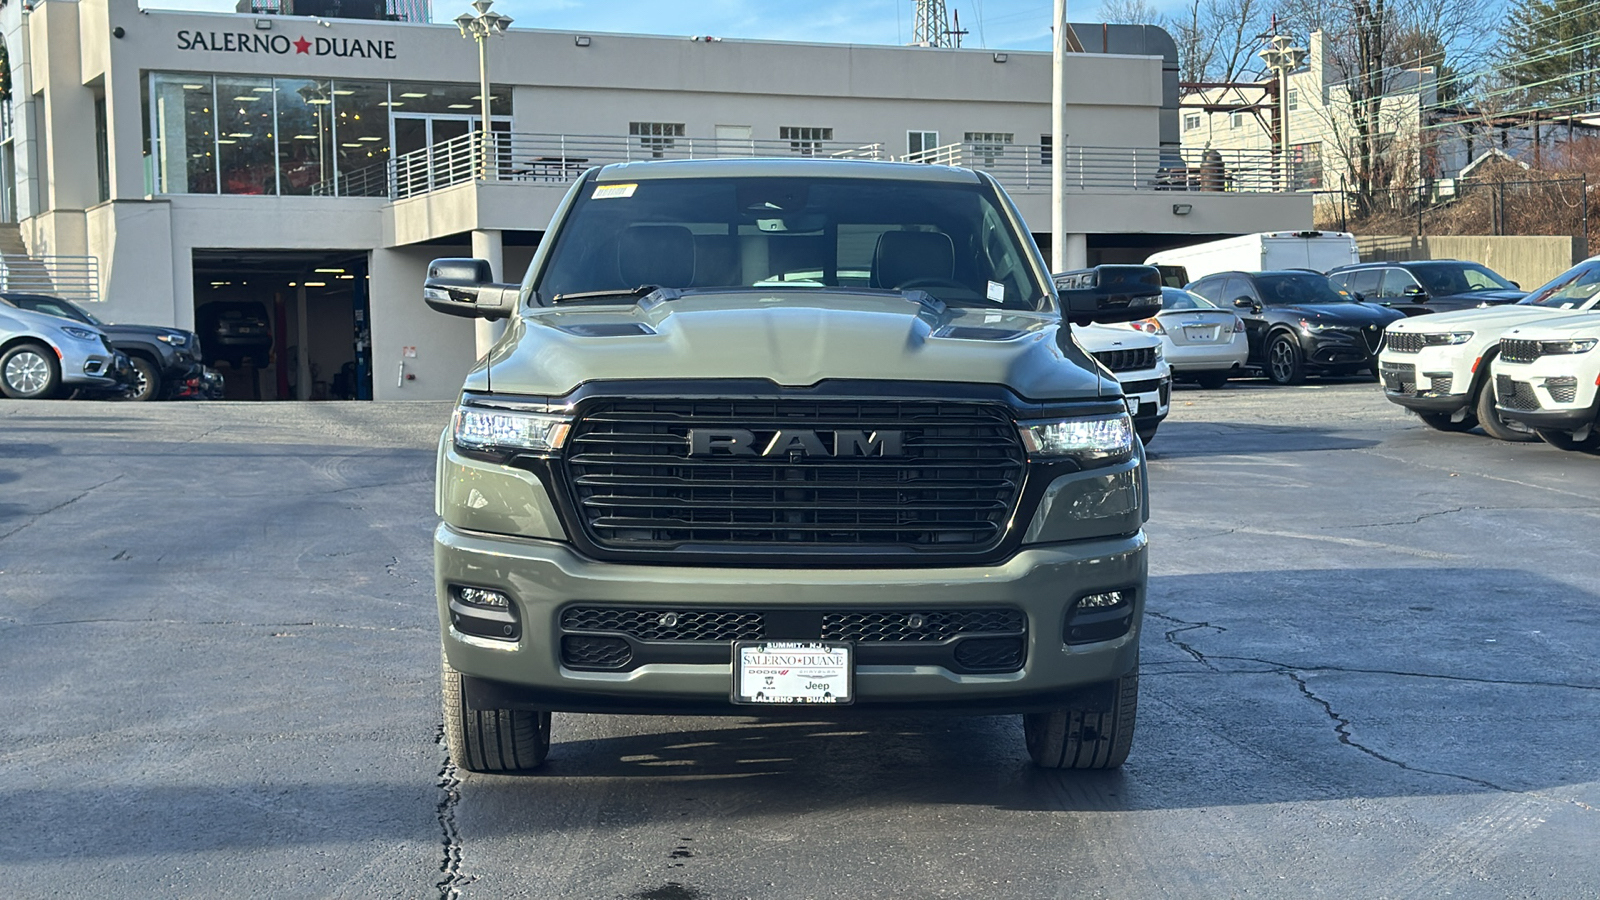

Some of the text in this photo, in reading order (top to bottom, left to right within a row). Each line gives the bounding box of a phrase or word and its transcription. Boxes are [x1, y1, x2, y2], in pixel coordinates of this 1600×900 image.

[177, 30, 397, 59] SALERNO DUANE
[687, 429, 905, 457] RAM
[743, 655, 844, 666] SALERNO DUANE
[805, 681, 830, 691] Jeep
